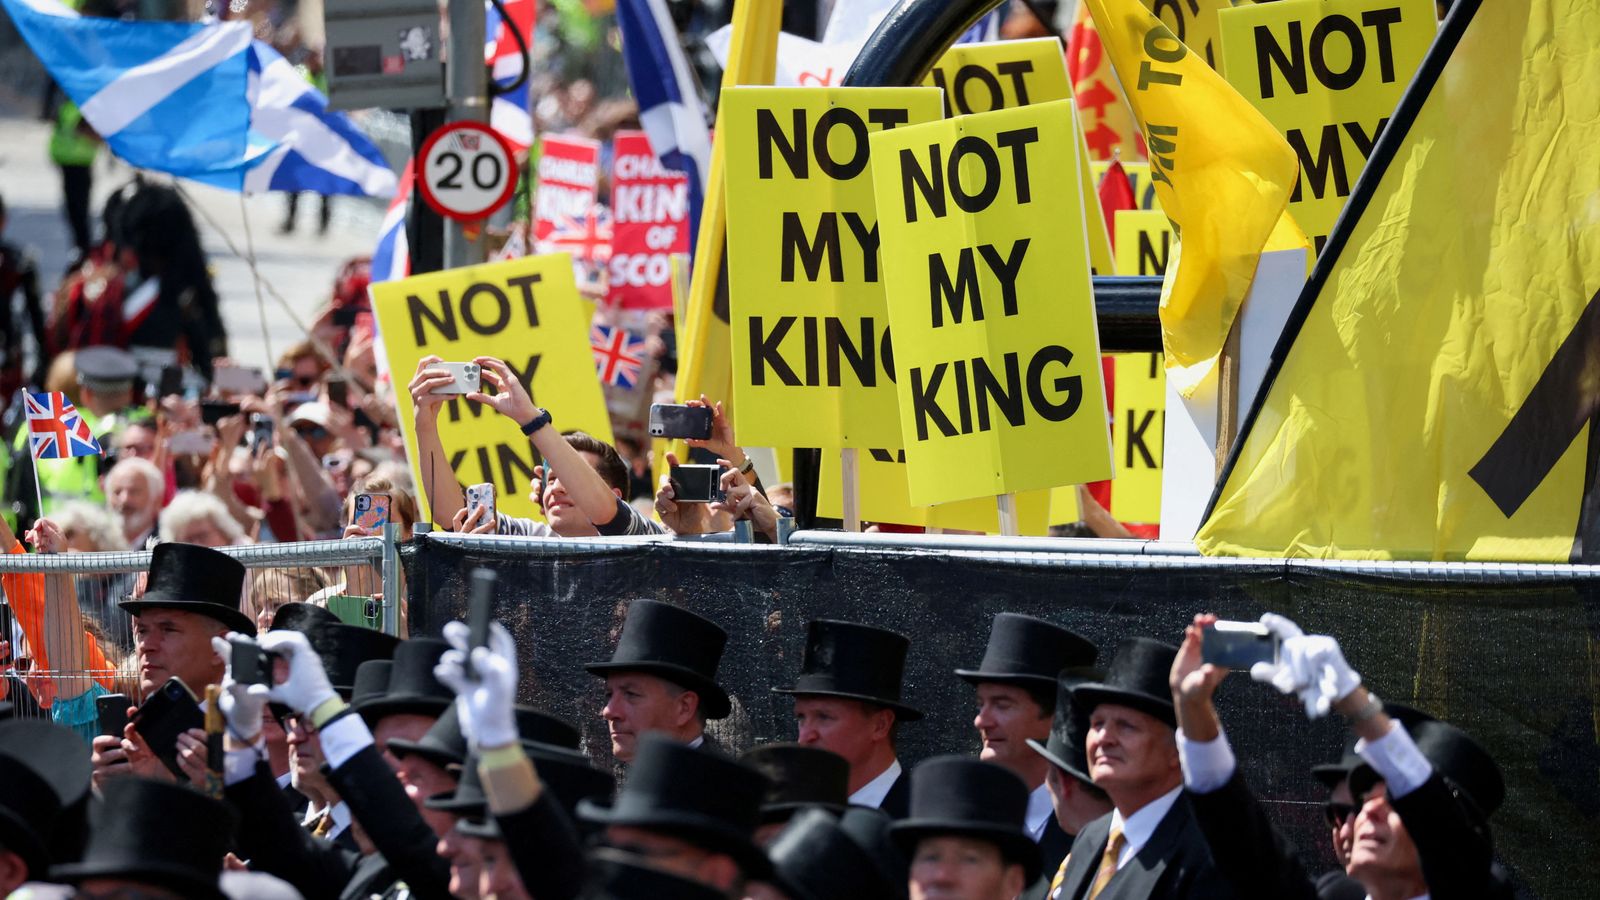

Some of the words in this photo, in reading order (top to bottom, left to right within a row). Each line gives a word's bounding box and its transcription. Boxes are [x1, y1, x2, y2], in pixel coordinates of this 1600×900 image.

[1253, 7, 1402, 99] NOT
[435, 152, 502, 190] 20
[613, 183, 688, 224] KIN
[900, 127, 1039, 223] NOT
[645, 225, 678, 250] OF
[781, 212, 880, 282] MY
[406, 274, 541, 347] NOT
[929, 238, 1031, 328] MY
[749, 316, 897, 387] KIN
[910, 345, 1083, 442] KING
